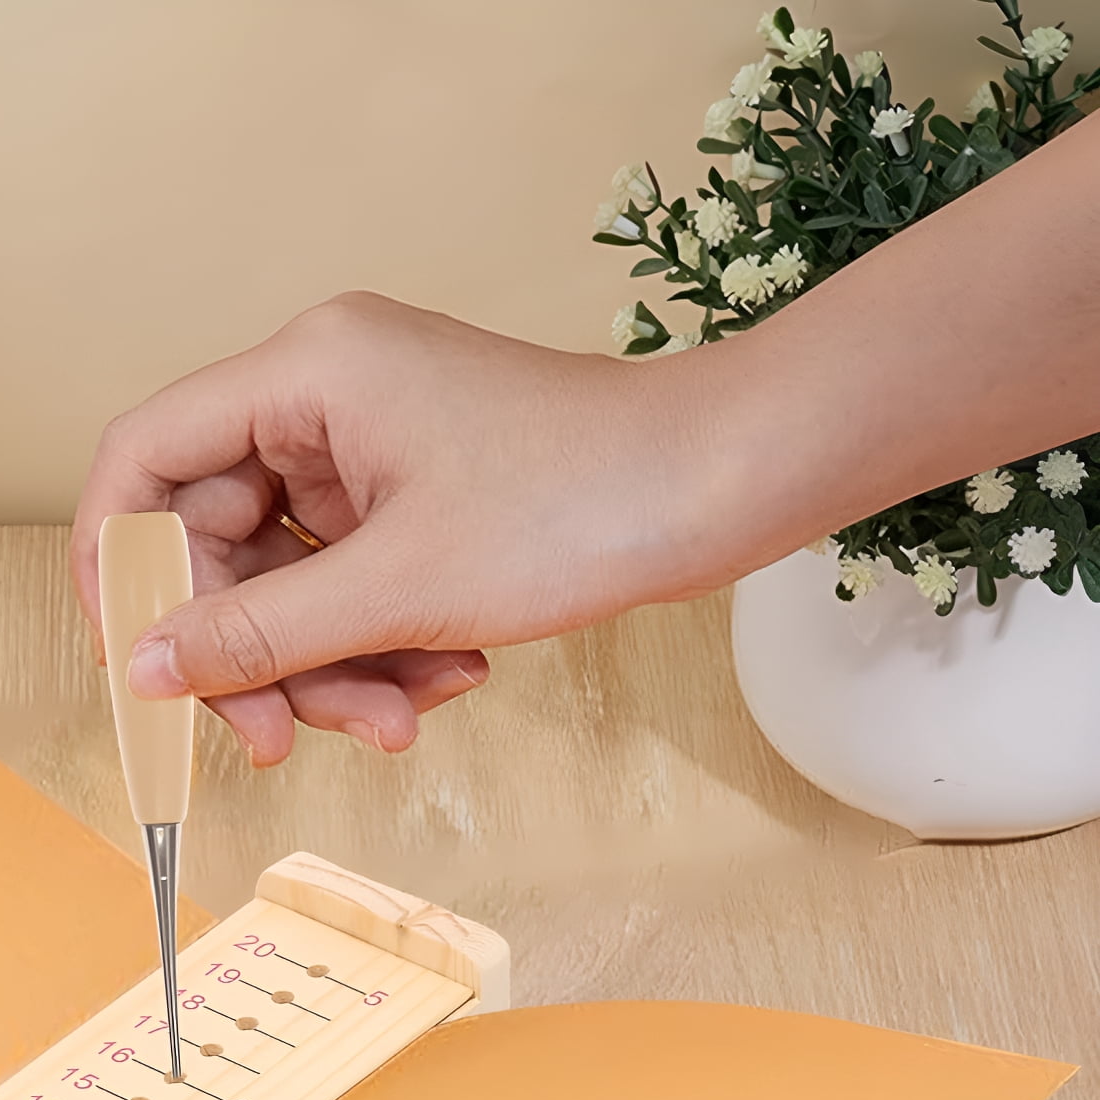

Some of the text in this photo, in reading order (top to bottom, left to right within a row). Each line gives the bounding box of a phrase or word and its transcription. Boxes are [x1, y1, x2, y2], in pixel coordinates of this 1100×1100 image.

[233, 934, 276, 958] 20
[204, 963, 241, 984] 19
[363, 990, 389, 1006] 5
[134, 1015, 169, 1034] 17
[97, 1041, 136, 1063] 16
[60, 1067, 100, 1090] 15
